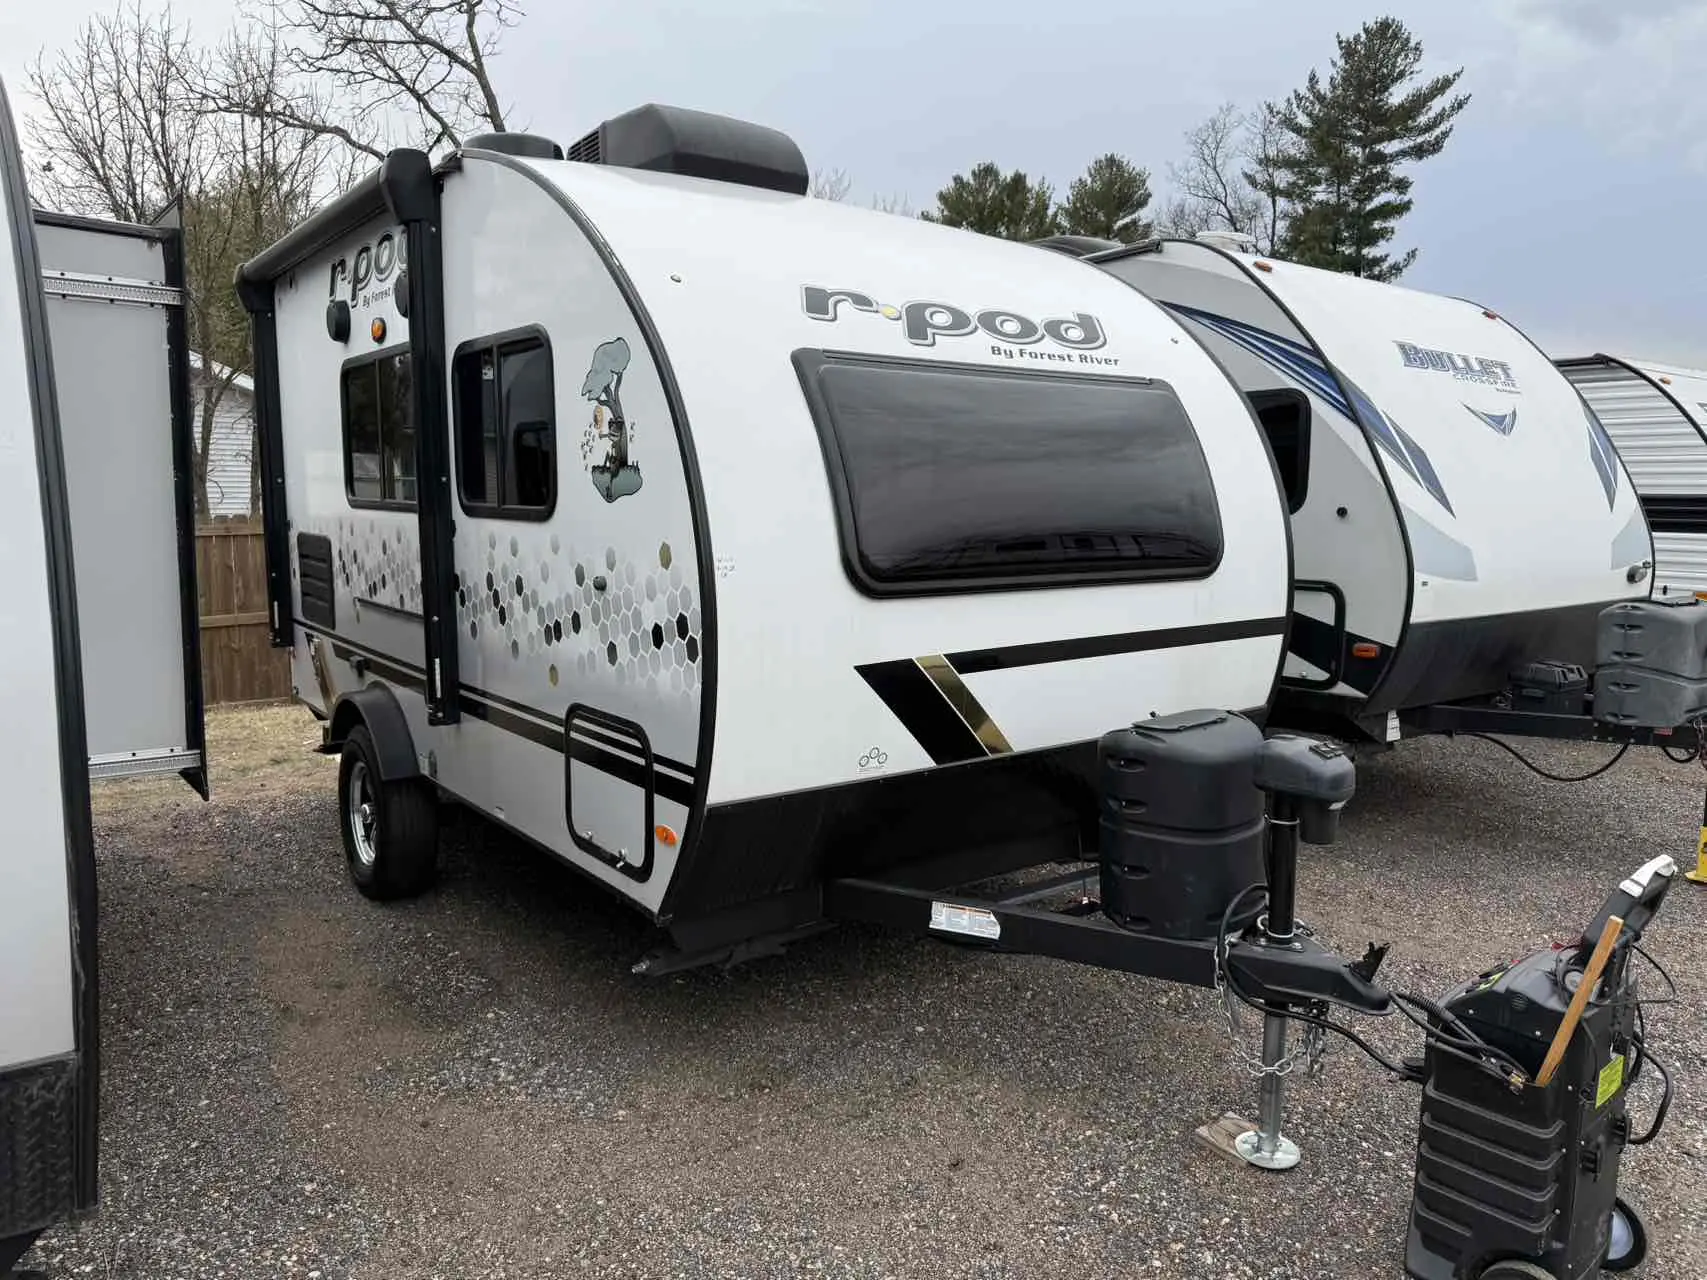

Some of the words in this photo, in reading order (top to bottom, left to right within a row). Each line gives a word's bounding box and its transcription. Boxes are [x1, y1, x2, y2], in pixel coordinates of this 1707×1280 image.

[991, 345, 1014, 359] By
[1018, 348, 1074, 363] Forest
[1079, 353, 1120, 366] River
[1394, 341, 1516, 382] BULLET
